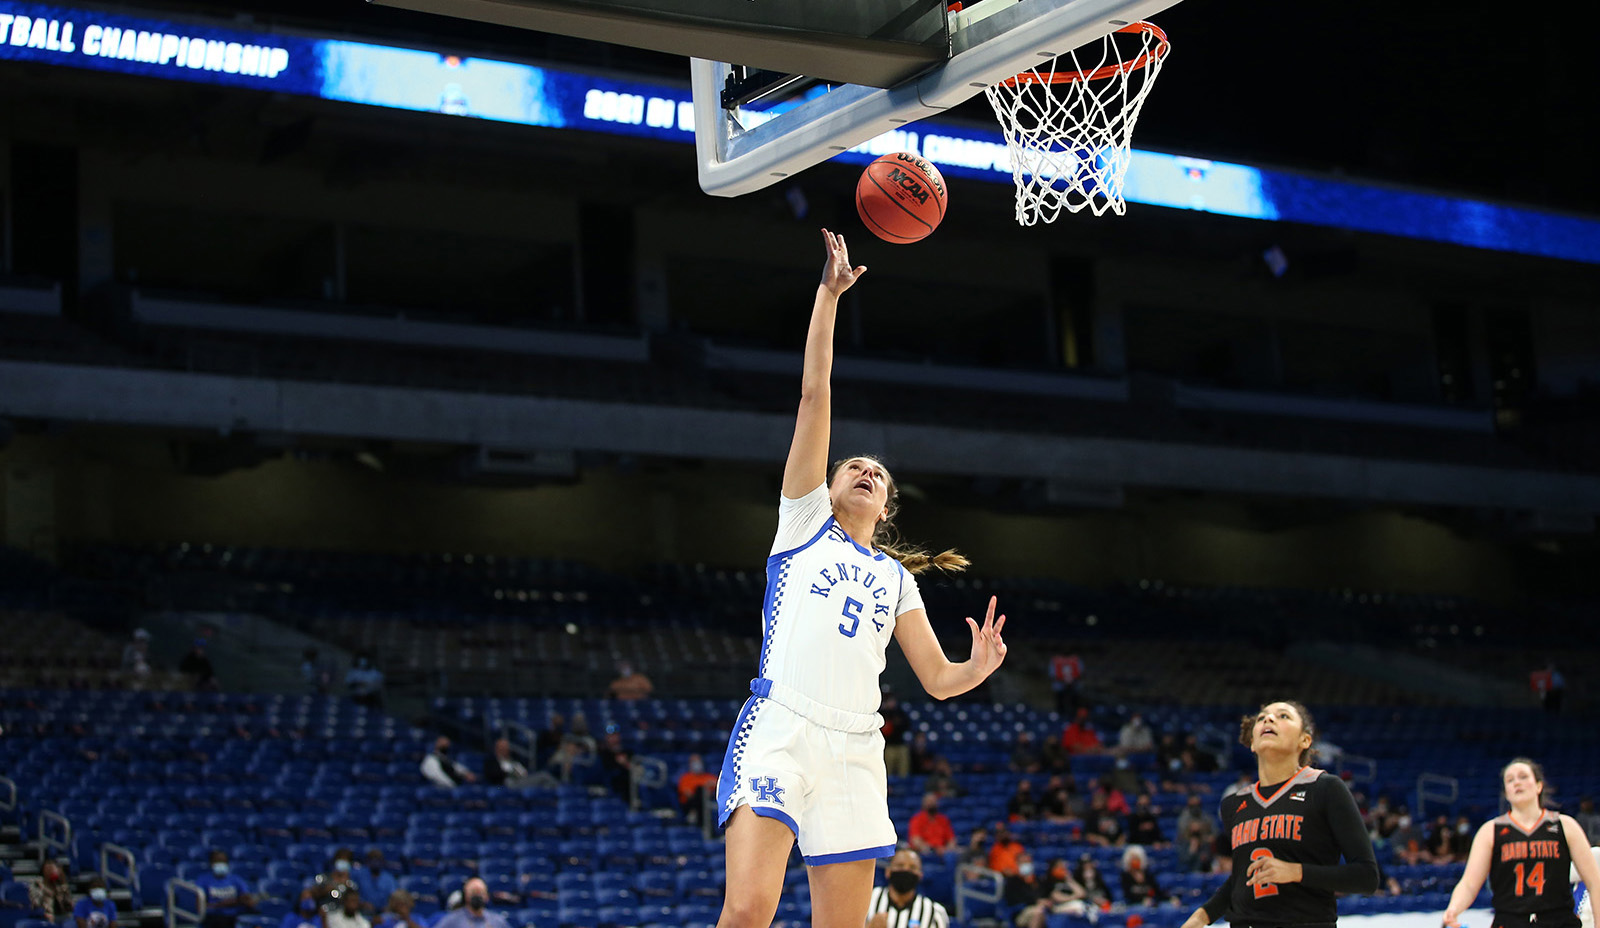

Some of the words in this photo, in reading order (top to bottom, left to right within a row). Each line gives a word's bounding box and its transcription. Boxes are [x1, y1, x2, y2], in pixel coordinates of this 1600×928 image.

[82, 24, 289, 78] CHAMPIONSHIP
[888, 168, 930, 205] NCAA
[810, 562, 890, 633] KENTUCKY
[838, 596, 864, 638] 5
[749, 776, 785, 807] UK
[1260, 814, 1304, 841] STATE
[1529, 840, 1560, 859] STATE
[1514, 861, 1546, 897] 14
